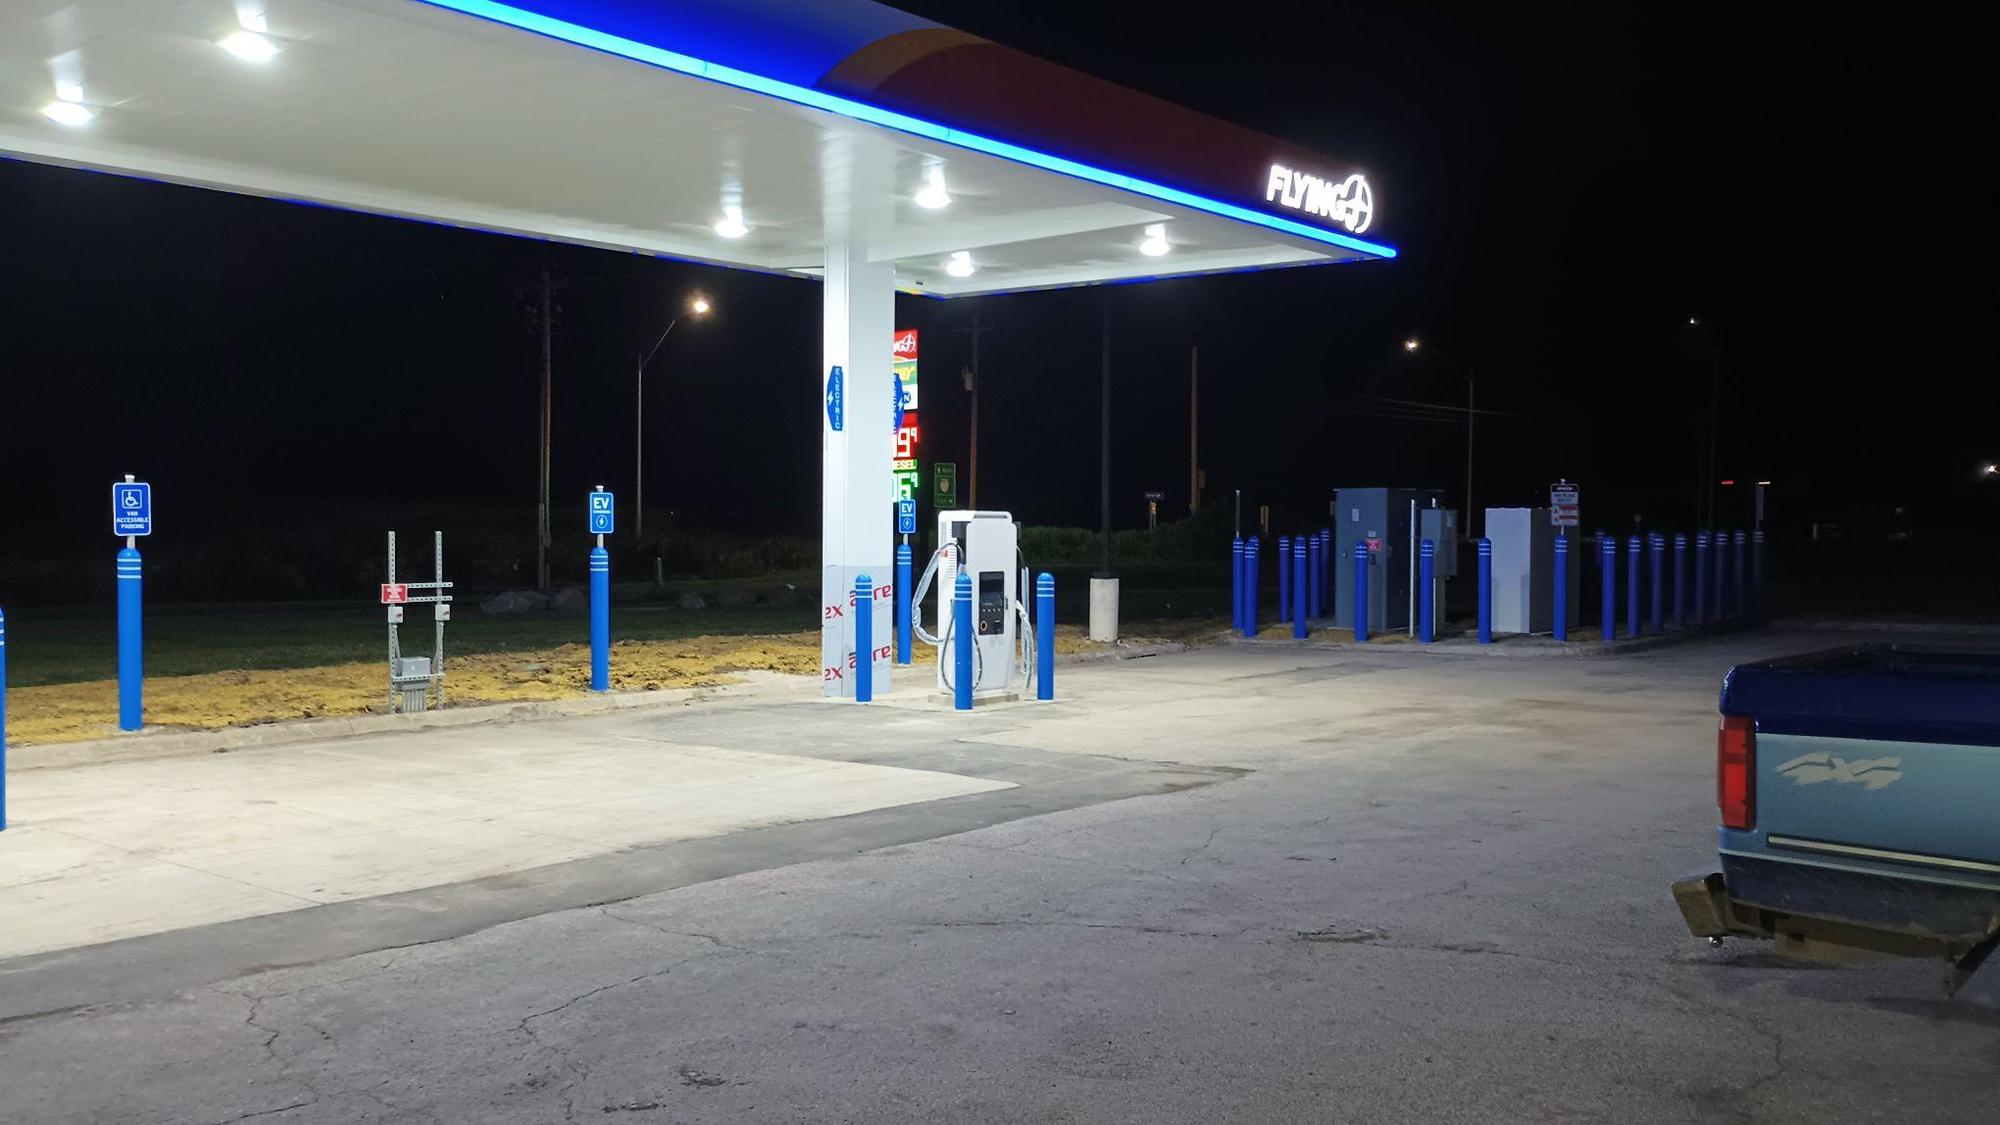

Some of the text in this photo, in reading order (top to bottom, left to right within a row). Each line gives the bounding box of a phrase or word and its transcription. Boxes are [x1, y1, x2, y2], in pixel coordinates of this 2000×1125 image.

[1266, 165, 1347, 222] FLYING
[593, 497, 610, 509] EV
[901, 503, 913, 513] EV
